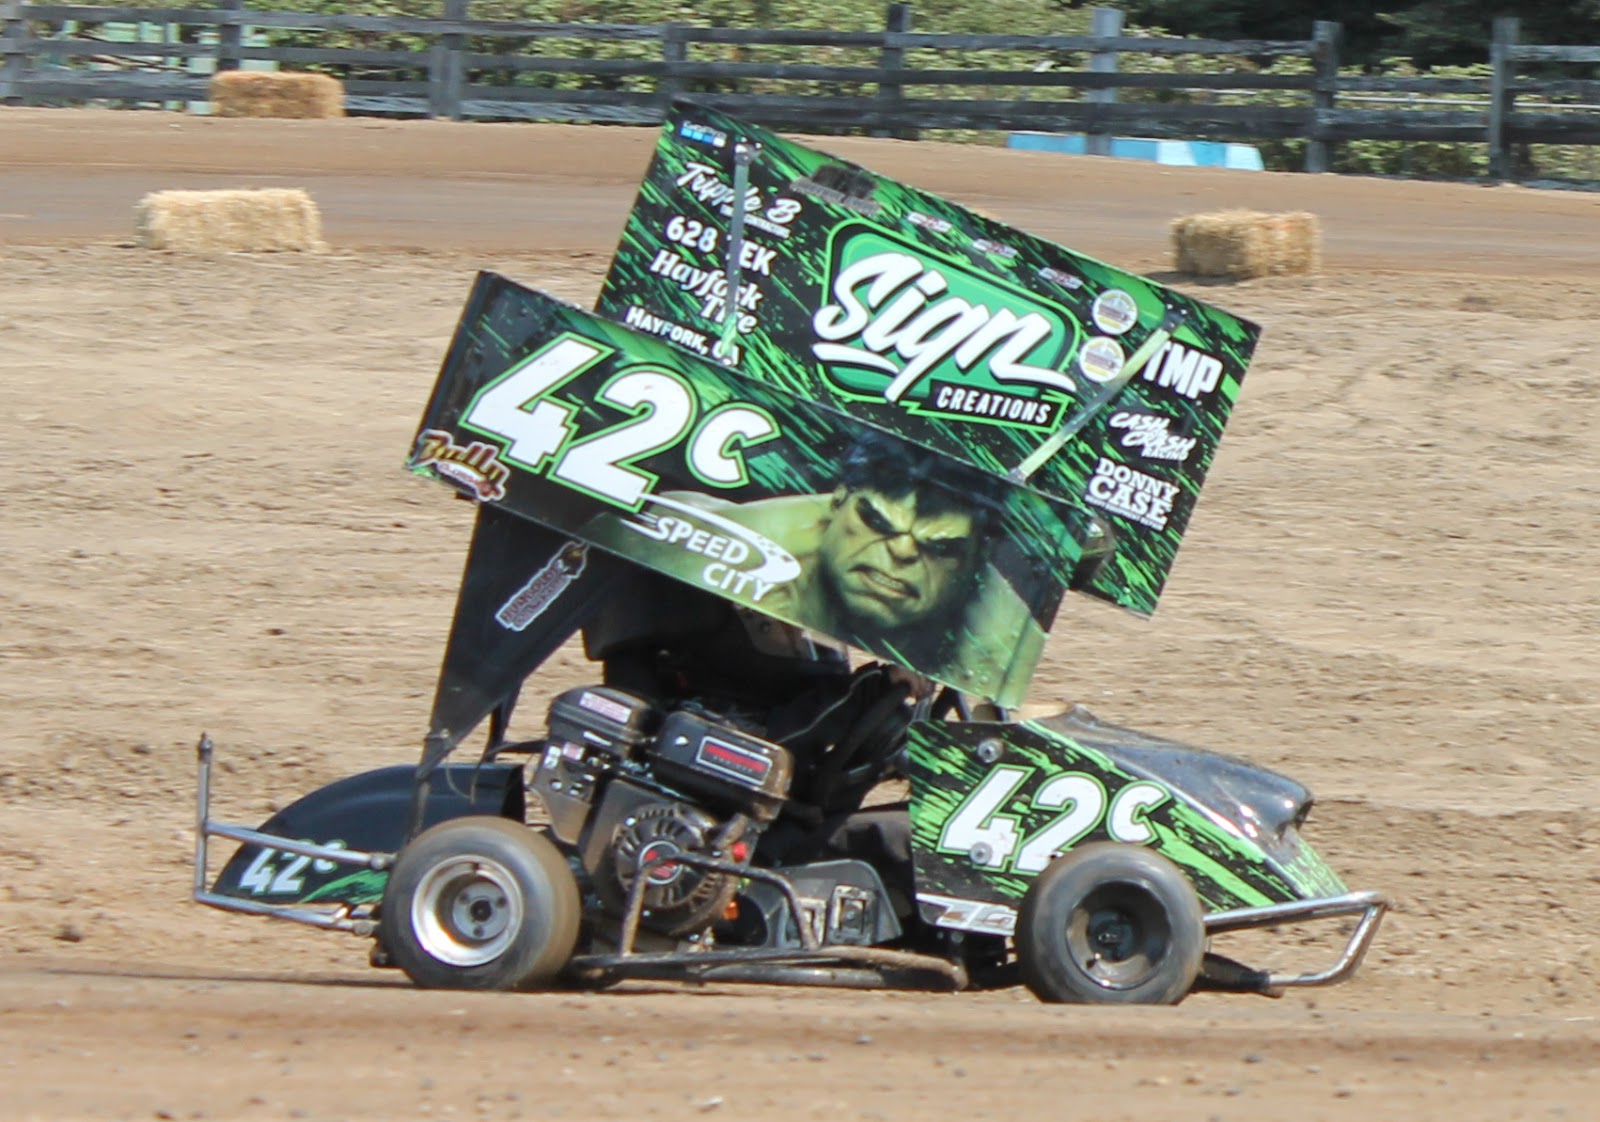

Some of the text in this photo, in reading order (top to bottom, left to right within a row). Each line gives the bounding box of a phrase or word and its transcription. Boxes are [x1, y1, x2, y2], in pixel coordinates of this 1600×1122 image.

[766, 198, 802, 223] B
[666, 216, 718, 253] 628
[651, 249, 763, 310] Hayfork
[812, 252, 1076, 402] Sign
[1143, 340, 1224, 400] TMP
[936, 386, 1051, 425] CREATIONS
[1089, 475, 1173, 525] CASE
[1095, 457, 1180, 502] DONNY
[655, 516, 749, 564] SPEED
[703, 563, 775, 601] CITY
